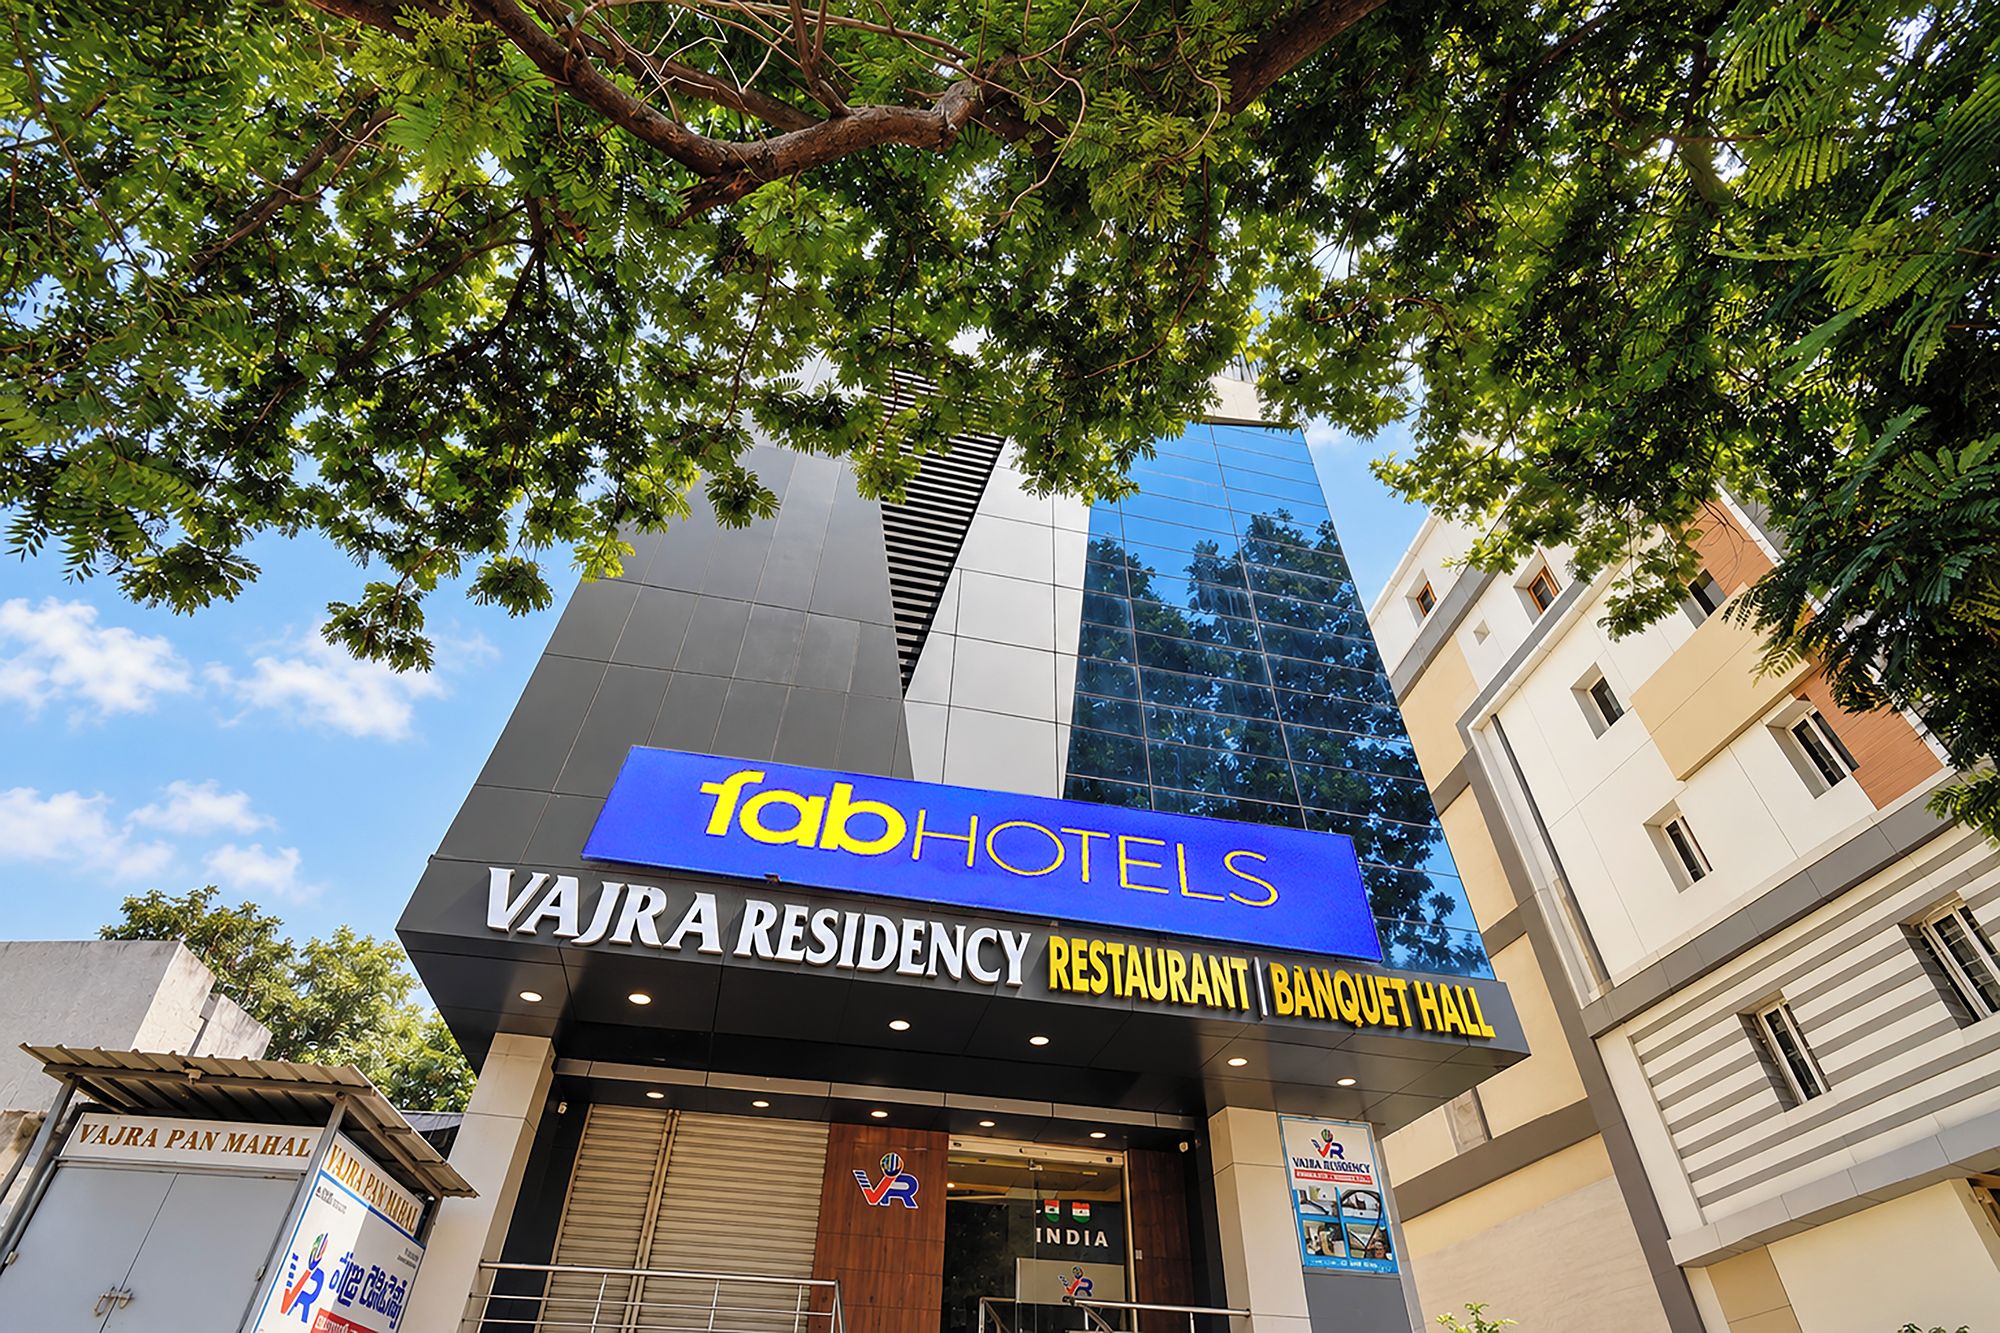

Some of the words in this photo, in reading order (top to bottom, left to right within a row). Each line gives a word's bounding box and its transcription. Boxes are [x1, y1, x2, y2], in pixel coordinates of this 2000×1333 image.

[487, 866, 723, 954] VAJRA
[733, 898, 1031, 987] RESIDENCY
[1048, 935, 1250, 1011] RESTAURANT
[1269, 962, 1413, 1029] BANQUET
[1411, 980, 1497, 1039] HALL
[79, 1124, 158, 1148] VAJRA
[164, 1129, 220, 1151] PAN
[221, 1132, 312, 1158] MAHAL
[327, 1144, 365, 1191] VAJRA
[1036, 1227, 1109, 1248] INDIA
